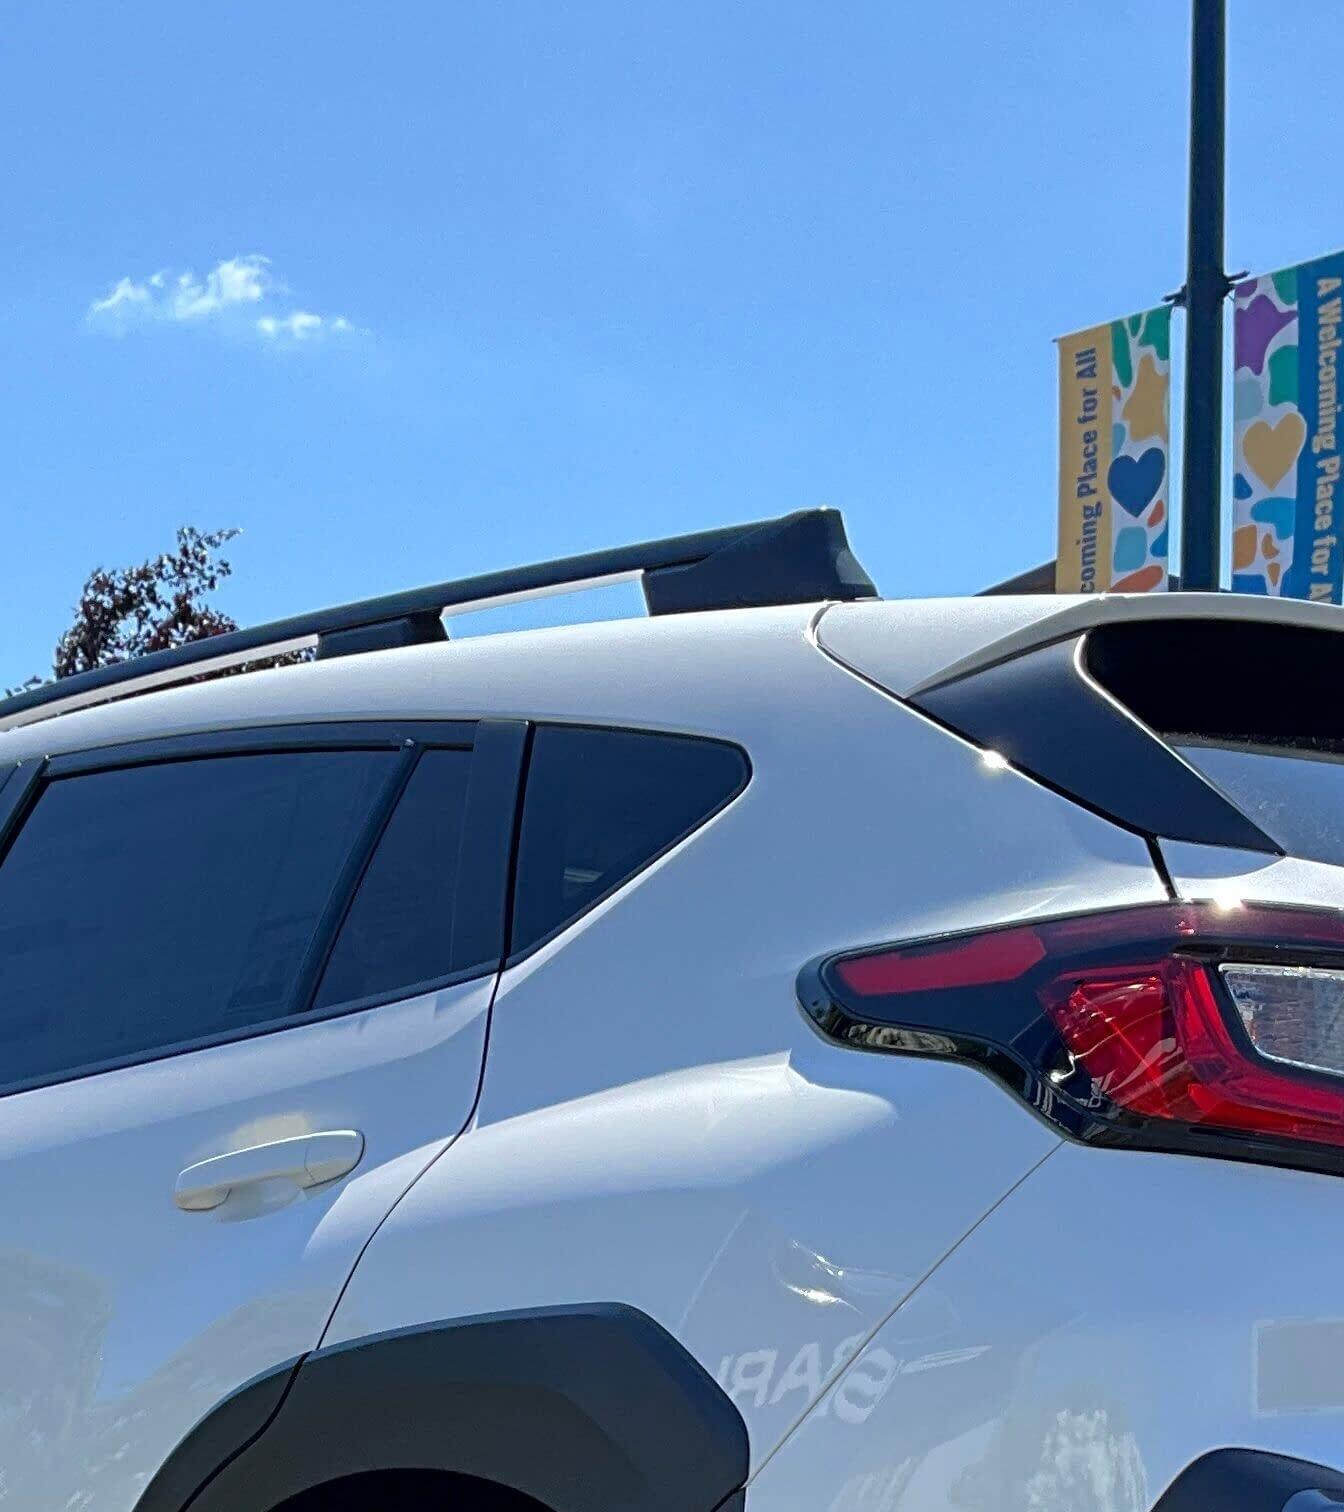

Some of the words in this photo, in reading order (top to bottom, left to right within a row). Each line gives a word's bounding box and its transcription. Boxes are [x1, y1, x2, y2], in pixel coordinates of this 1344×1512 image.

[1317, 277, 1342, 297] A
[1075, 347, 1097, 380] All
[1312, 302, 1343, 454] Welcoming
[1077, 384, 1098, 427] for
[1077, 429, 1098, 499] Place
[1313, 455, 1341, 535] Place
[1310, 535, 1337, 576] for
